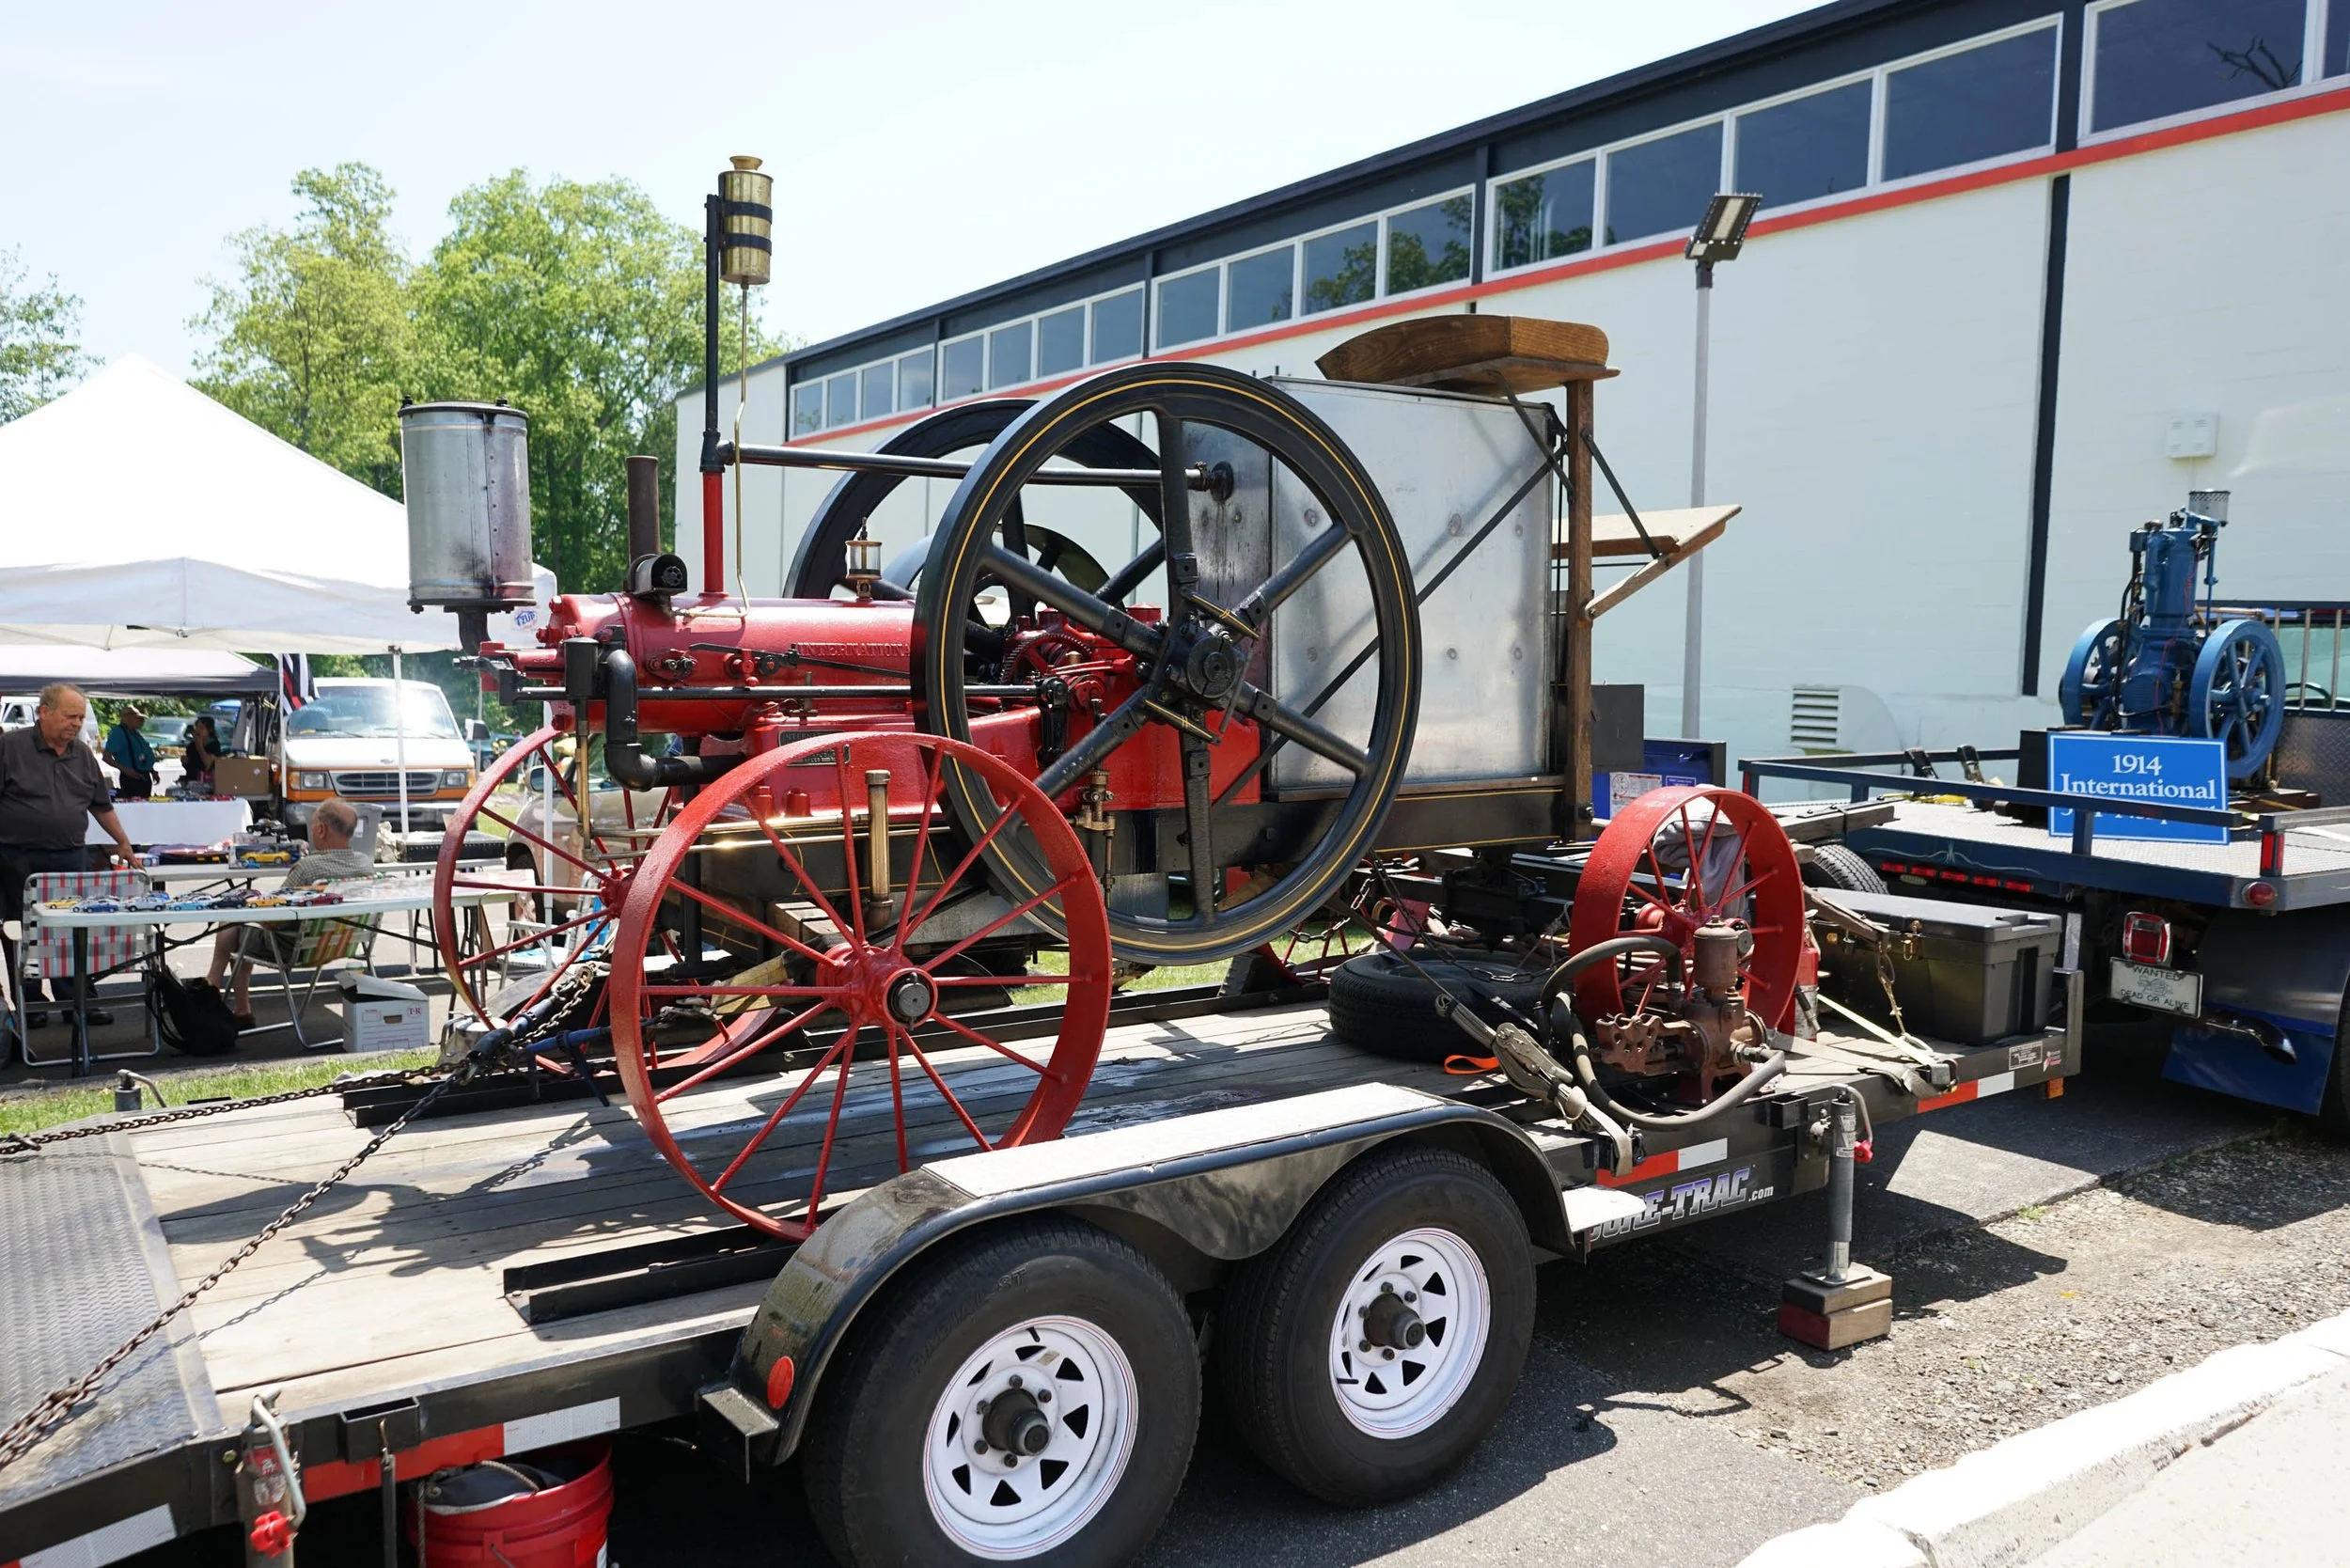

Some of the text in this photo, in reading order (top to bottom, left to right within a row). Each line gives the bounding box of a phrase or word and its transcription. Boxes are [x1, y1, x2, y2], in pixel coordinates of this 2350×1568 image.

[2112, 754, 2162, 776] 1914
[2060, 773, 2217, 800] International
[2134, 966, 2182, 981] WANTED
[2120, 988, 2190, 1011] DEAD OR ALIVE
